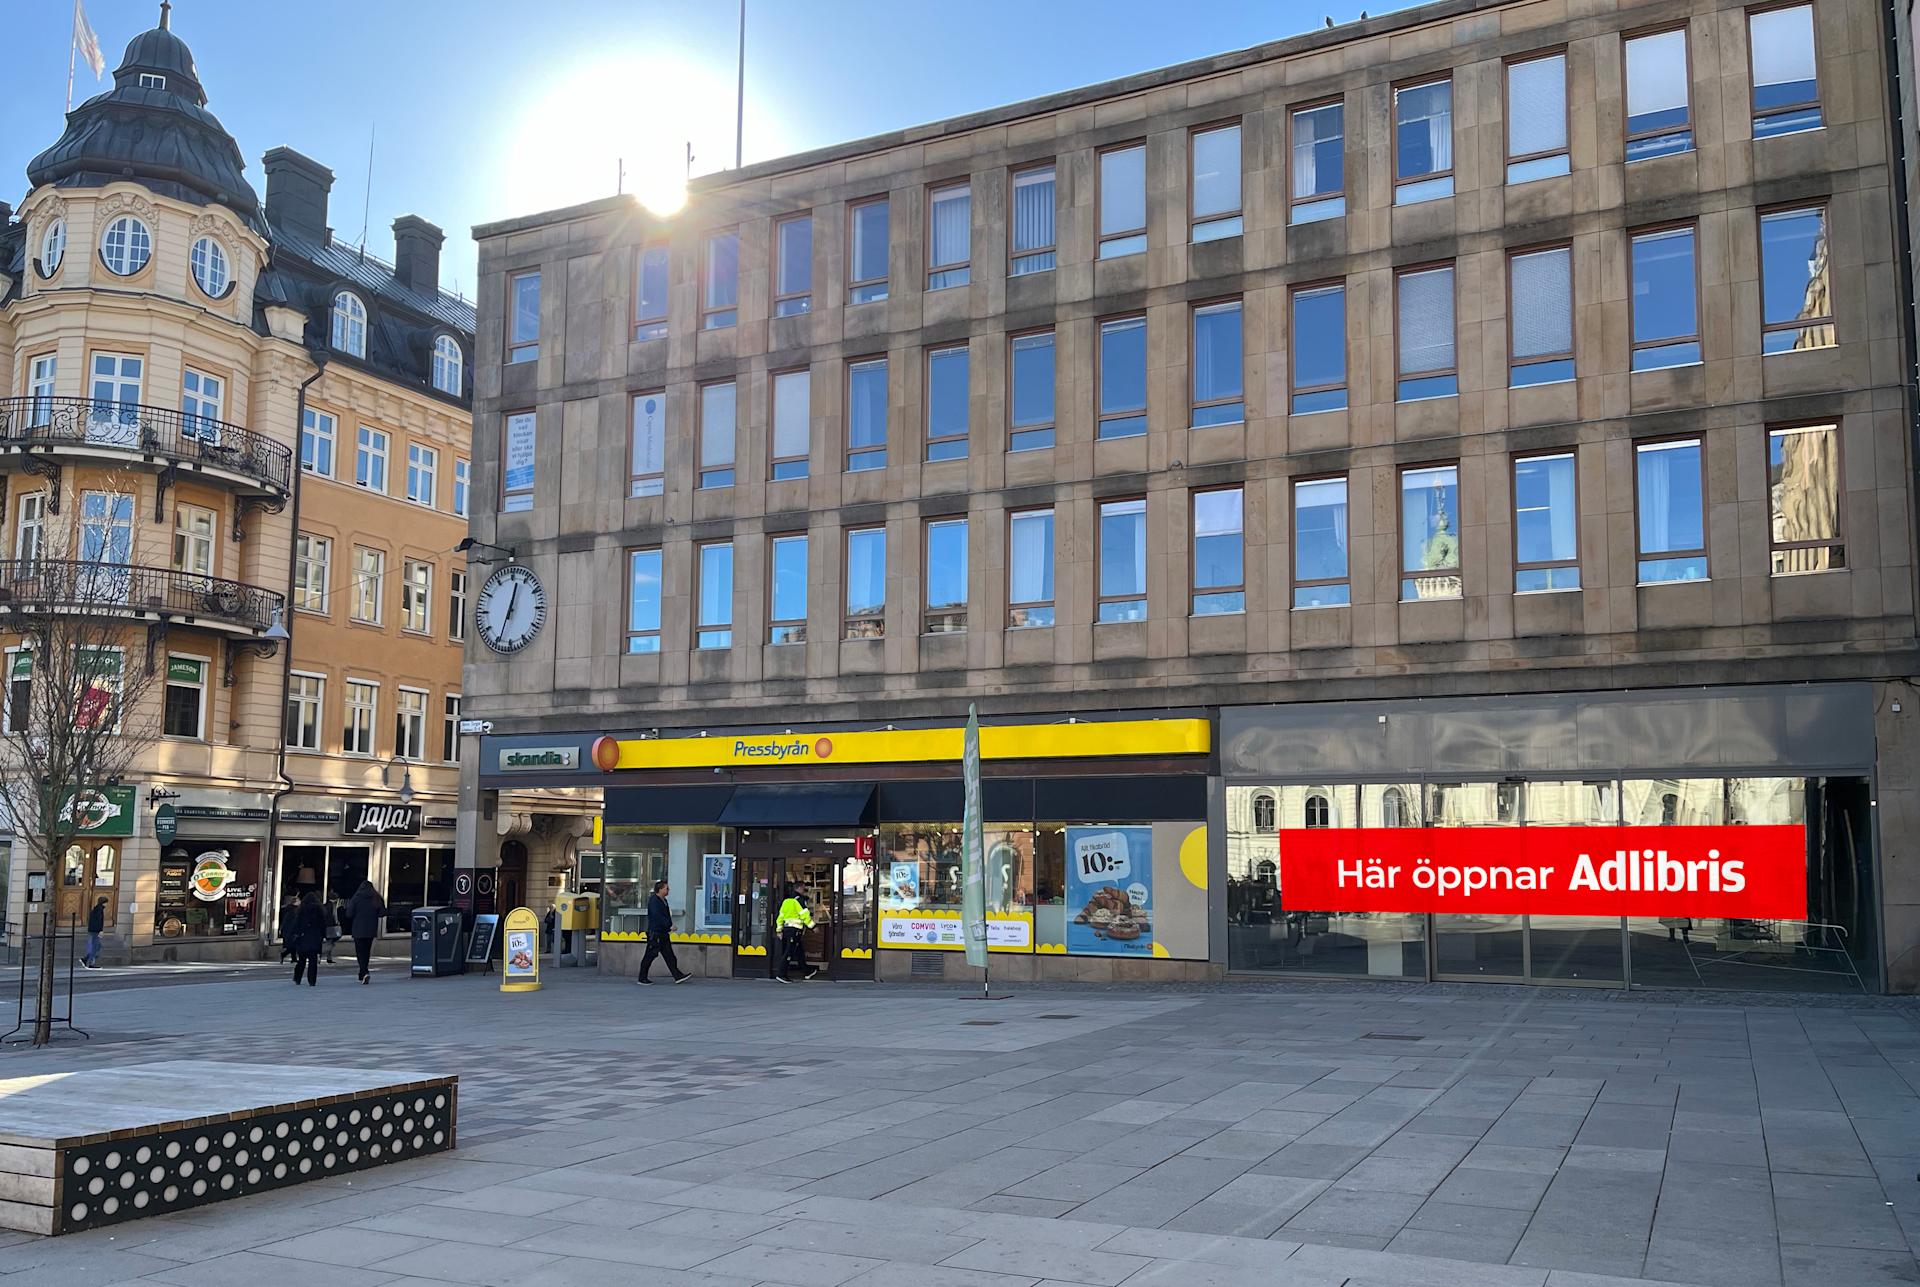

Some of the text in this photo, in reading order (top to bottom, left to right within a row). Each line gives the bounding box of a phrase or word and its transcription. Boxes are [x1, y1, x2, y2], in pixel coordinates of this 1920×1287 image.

[170, 664, 198, 674] JAMESON
[507, 751, 562, 767] skandia
[734, 740, 809, 760] Pressbyrån
[1082, 852, 1124, 875] 10:-
[1337, 849, 1746, 896] Här öppnar Adlibris
[911, 922, 936, 930] COMVIQ
